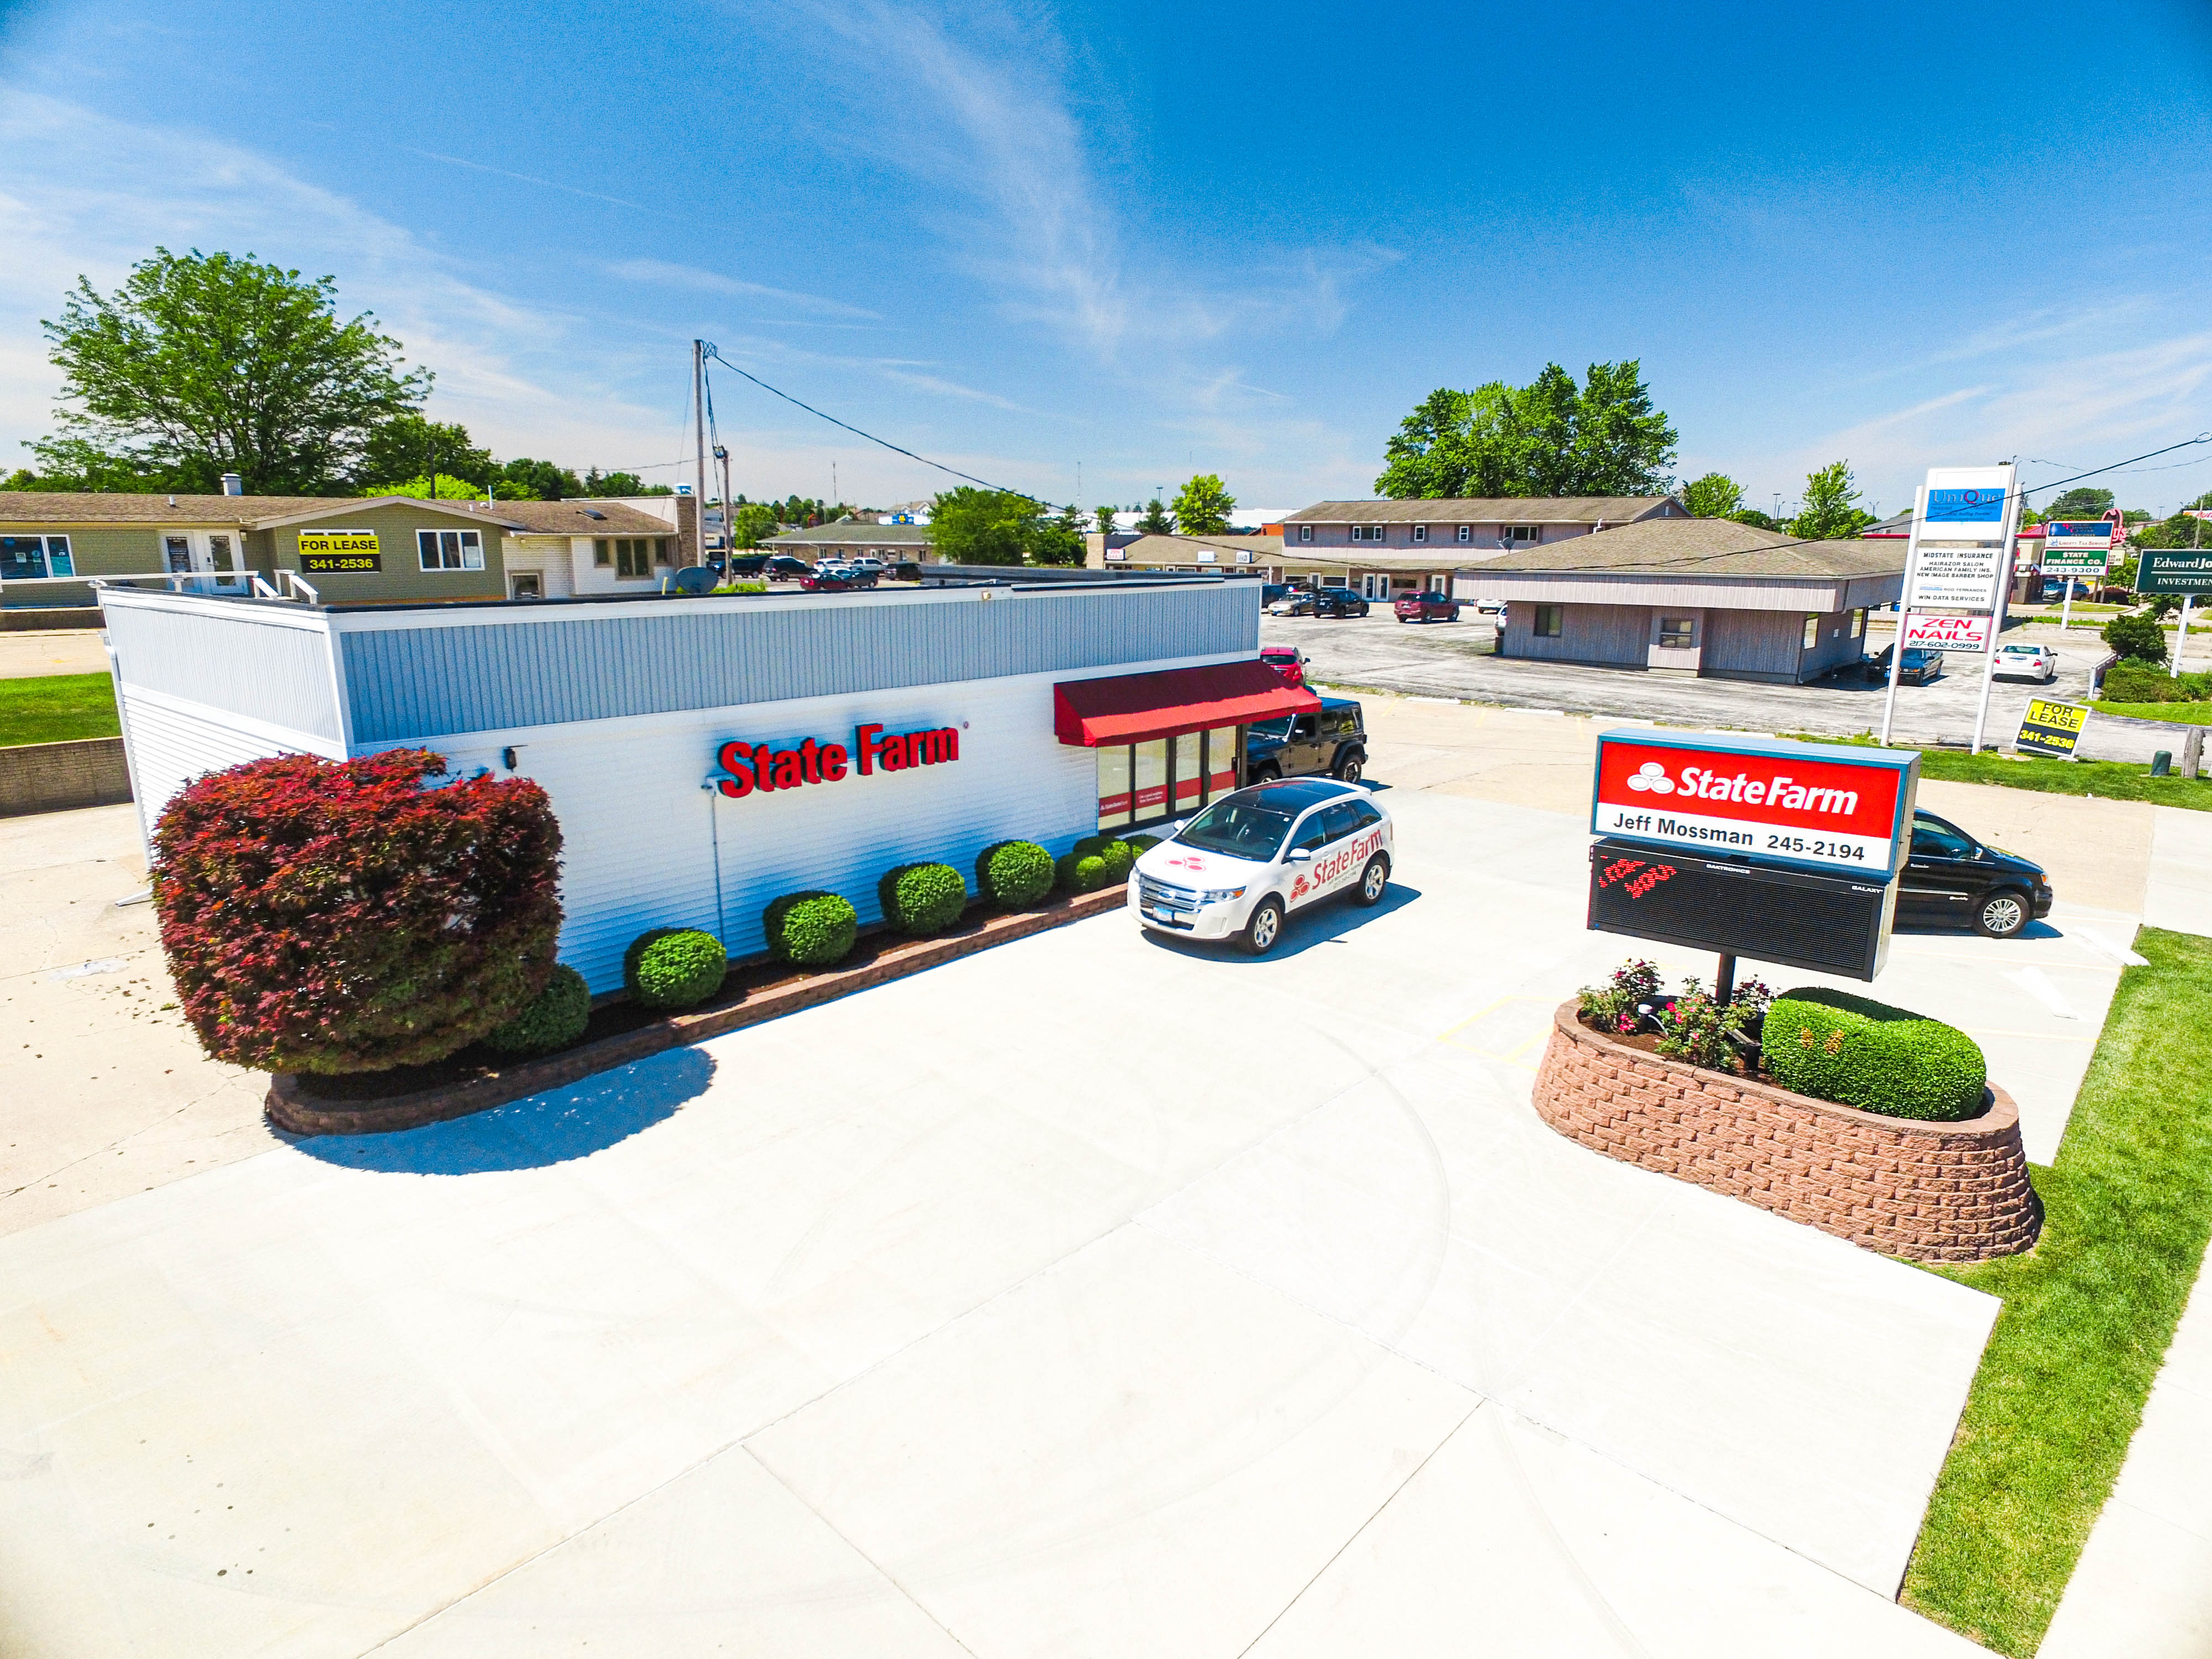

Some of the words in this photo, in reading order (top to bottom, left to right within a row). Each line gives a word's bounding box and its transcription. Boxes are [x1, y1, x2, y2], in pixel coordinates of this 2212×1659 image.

[301, 541, 329, 550] FOR
[333, 540, 377, 550] LEASE
[310, 559, 373, 569] 341-2536
[1922, 618, 1973, 629] ZEN
[1908, 629, 1984, 641] NAILS
[1909, 640, 1979, 649] 217-602-0999
[2042, 703, 2073, 717] FOR
[2030, 711, 2079, 728] LEASE
[2019, 730, 2075, 749] 341-2536
[719, 737, 848, 798] State
[855, 723, 959, 776] Farm
[1614, 813, 1651, 831] Jeff
[1657, 818, 1753, 846] Mossman
[1767, 835, 1865, 861] 245-2194
